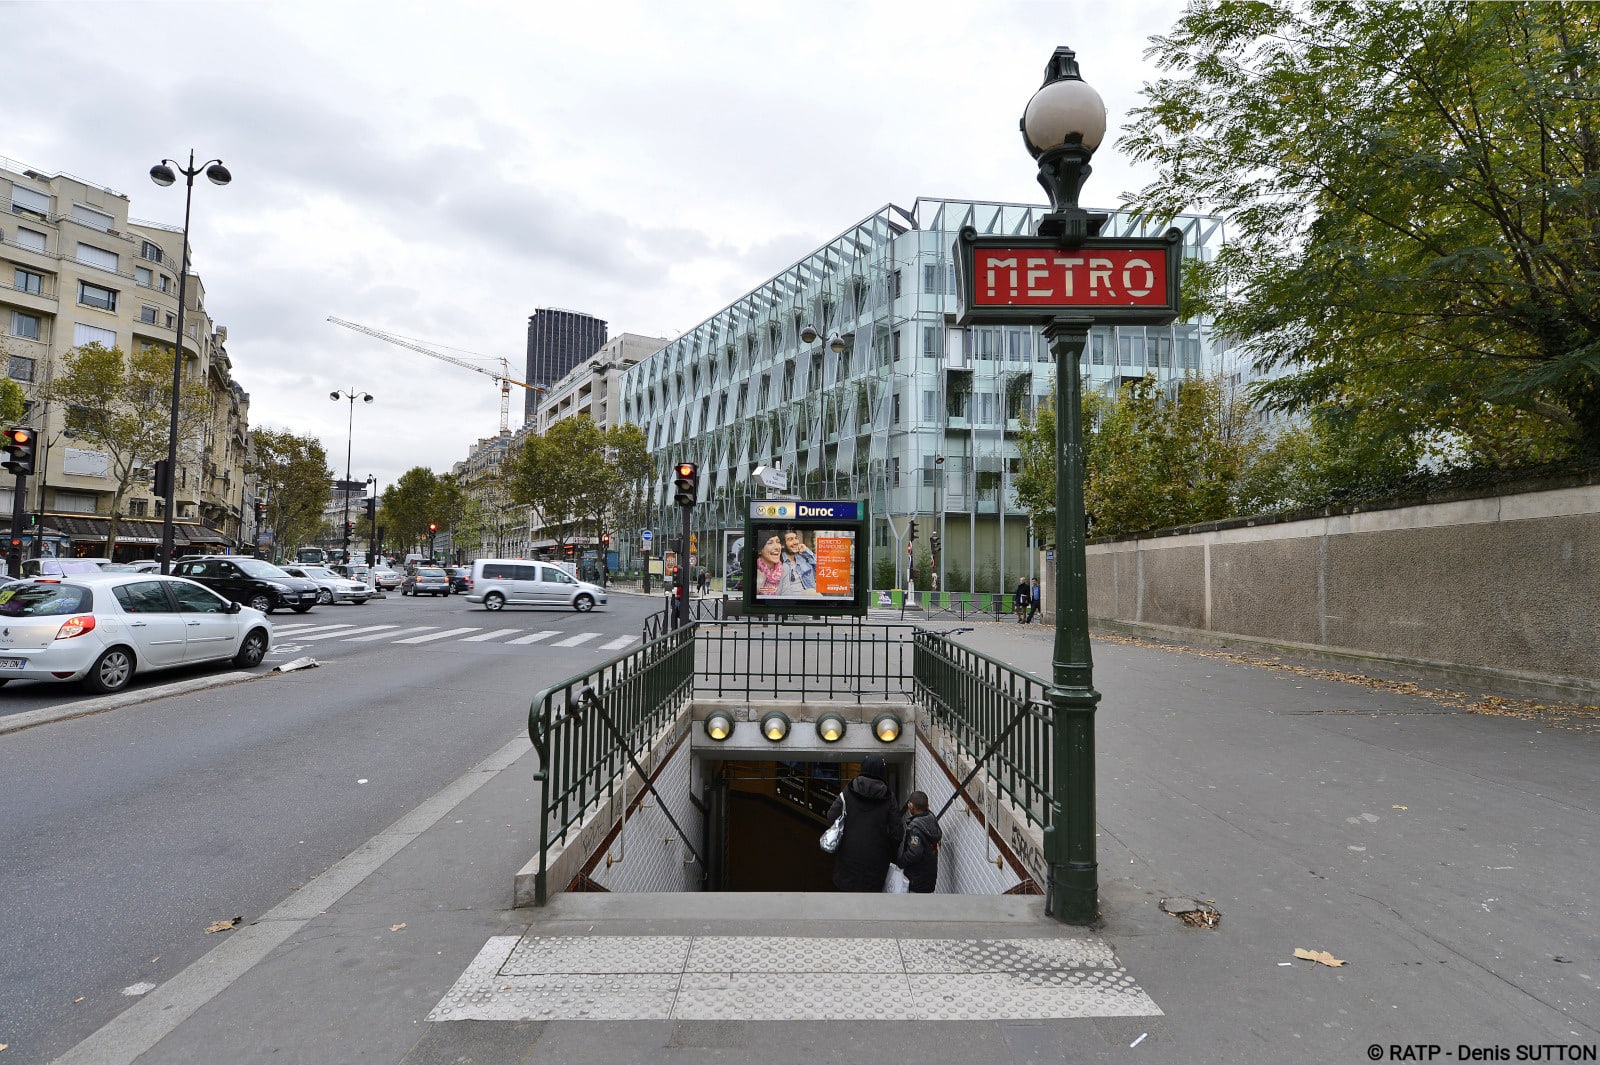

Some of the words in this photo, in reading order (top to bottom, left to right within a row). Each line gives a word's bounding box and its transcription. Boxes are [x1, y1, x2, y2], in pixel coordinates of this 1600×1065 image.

[986, 257, 1154, 298] METRO
[799, 505, 834, 517] Duroc
[818, 568, 839, 578] 42€
